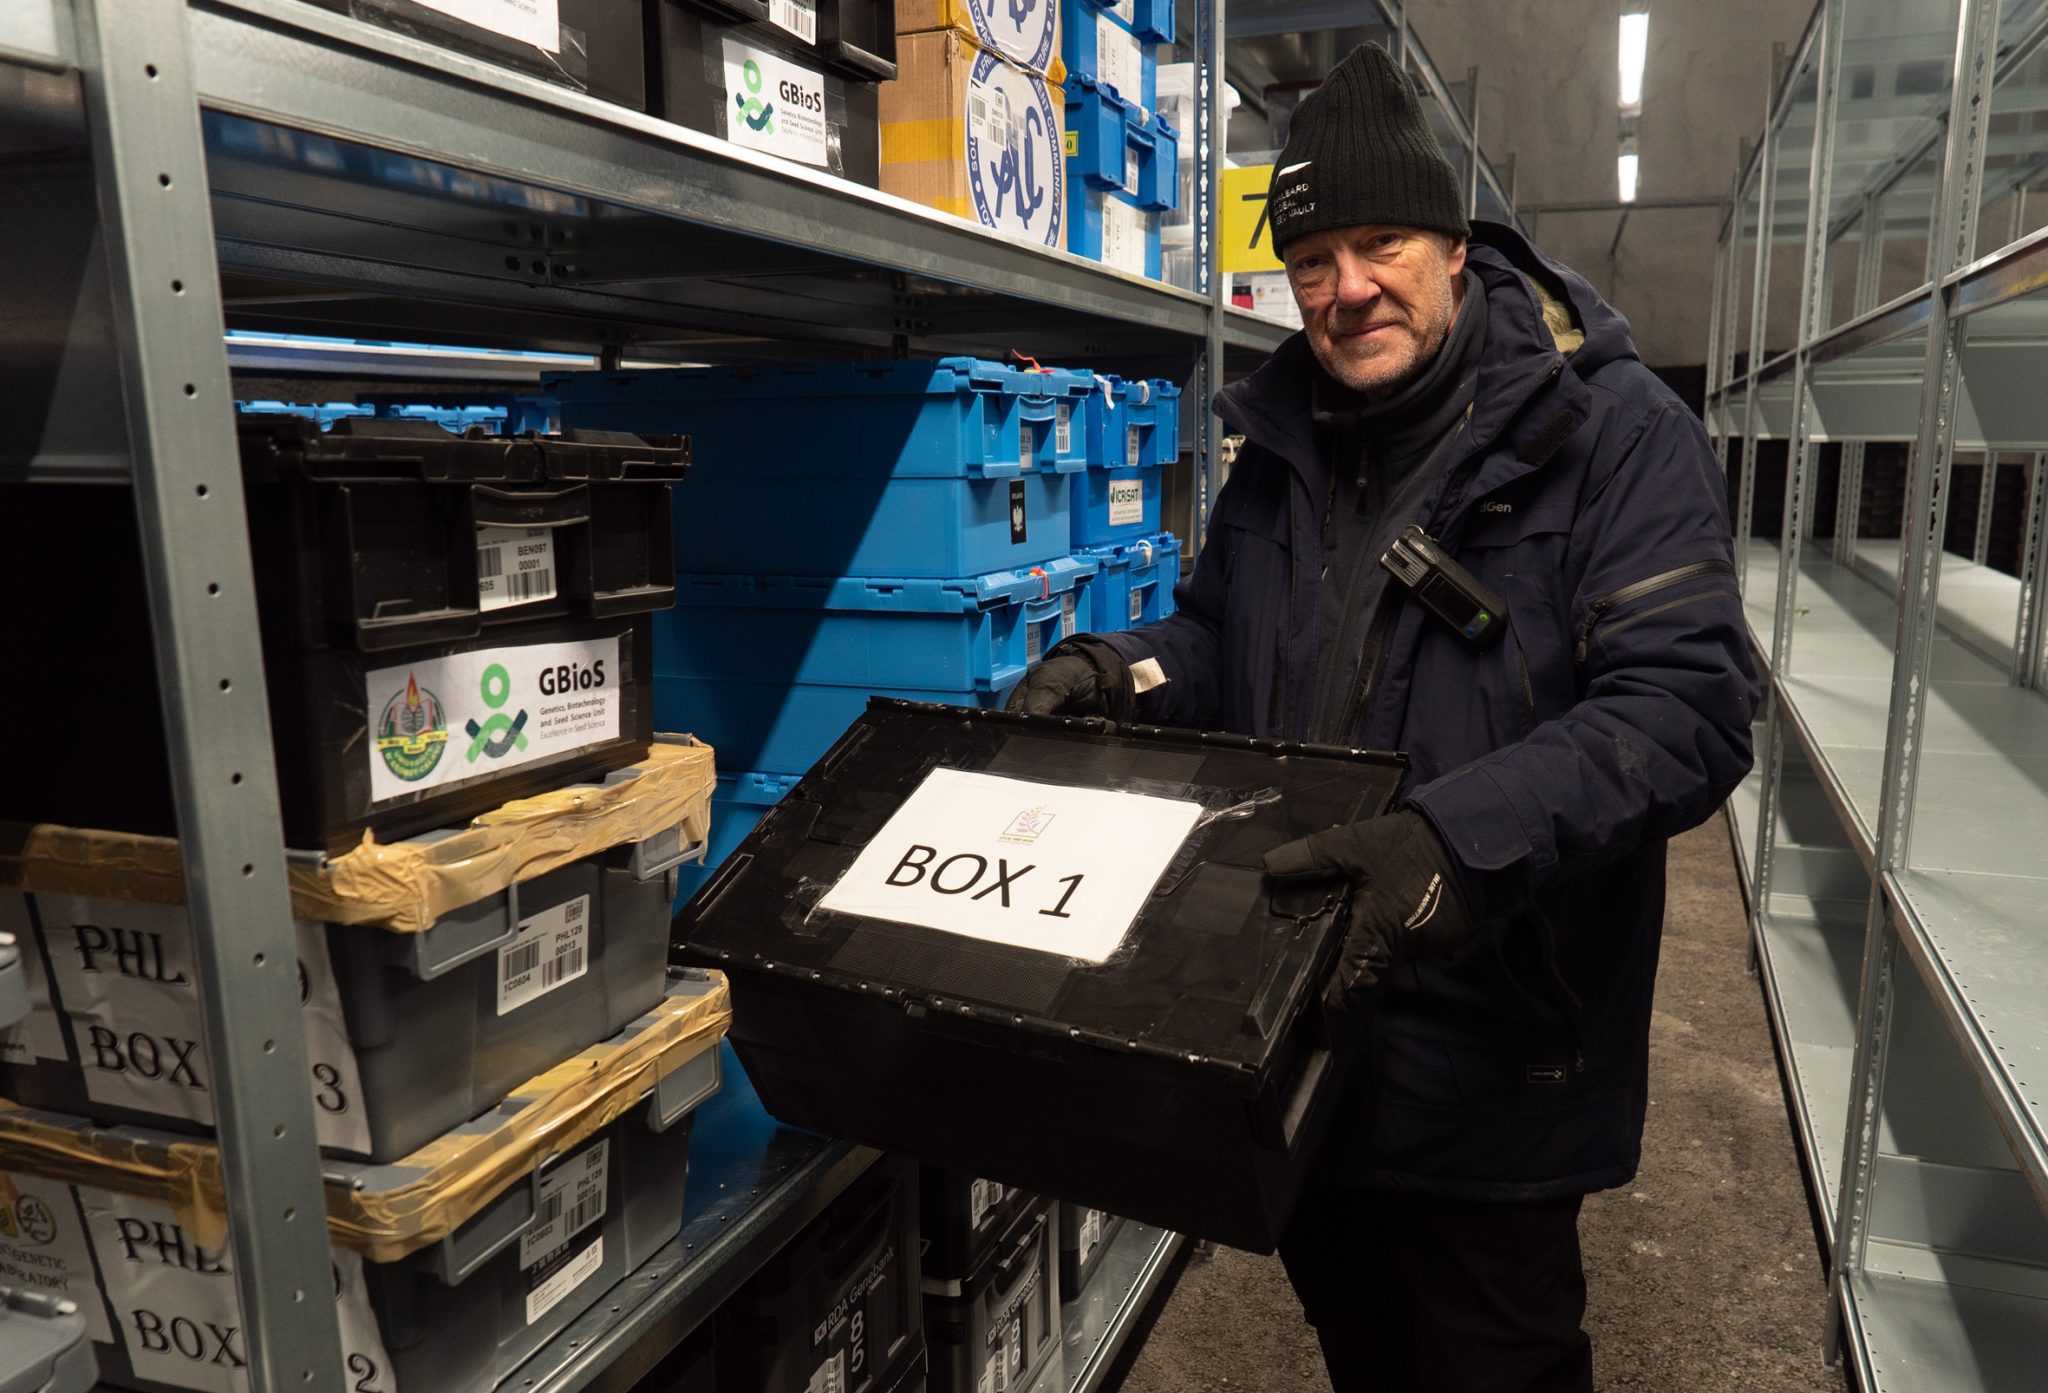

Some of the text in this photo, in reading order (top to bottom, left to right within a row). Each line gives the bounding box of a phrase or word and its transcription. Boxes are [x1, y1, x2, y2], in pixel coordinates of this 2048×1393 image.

[780, 80, 821, 112] GBioS
[1290, 202, 1316, 217] VAULT
[517, 543, 547, 556] BEN097
[518, 559, 540, 570] 00001
[539, 660, 605, 696] GBioS
[567, 697, 606, 710] Biotechnology
[540, 708, 605, 728] and Seed Science Unit
[540, 727, 567, 739] Excellence
[574, 722, 587, 732] Seed
[587, 720, 606, 730] Science
[884, 844, 1085, 919] BOX 1
[555, 924, 583, 943] PHL129
[72, 924, 190, 987] PHL
[555, 940, 576, 956] 00013
[89, 1025, 349, 1114] BOX 3
[577, 1168, 603, 1190] PHL129
[12, 1250, 67, 1271] GENETIC
[0, 1264, 69, 1292] ABORATORY
[826, 1246, 896, 1331] RDA Genebank
[996, 1308, 1011, 1337] RDA
[132, 1309, 247, 1368] BOX
